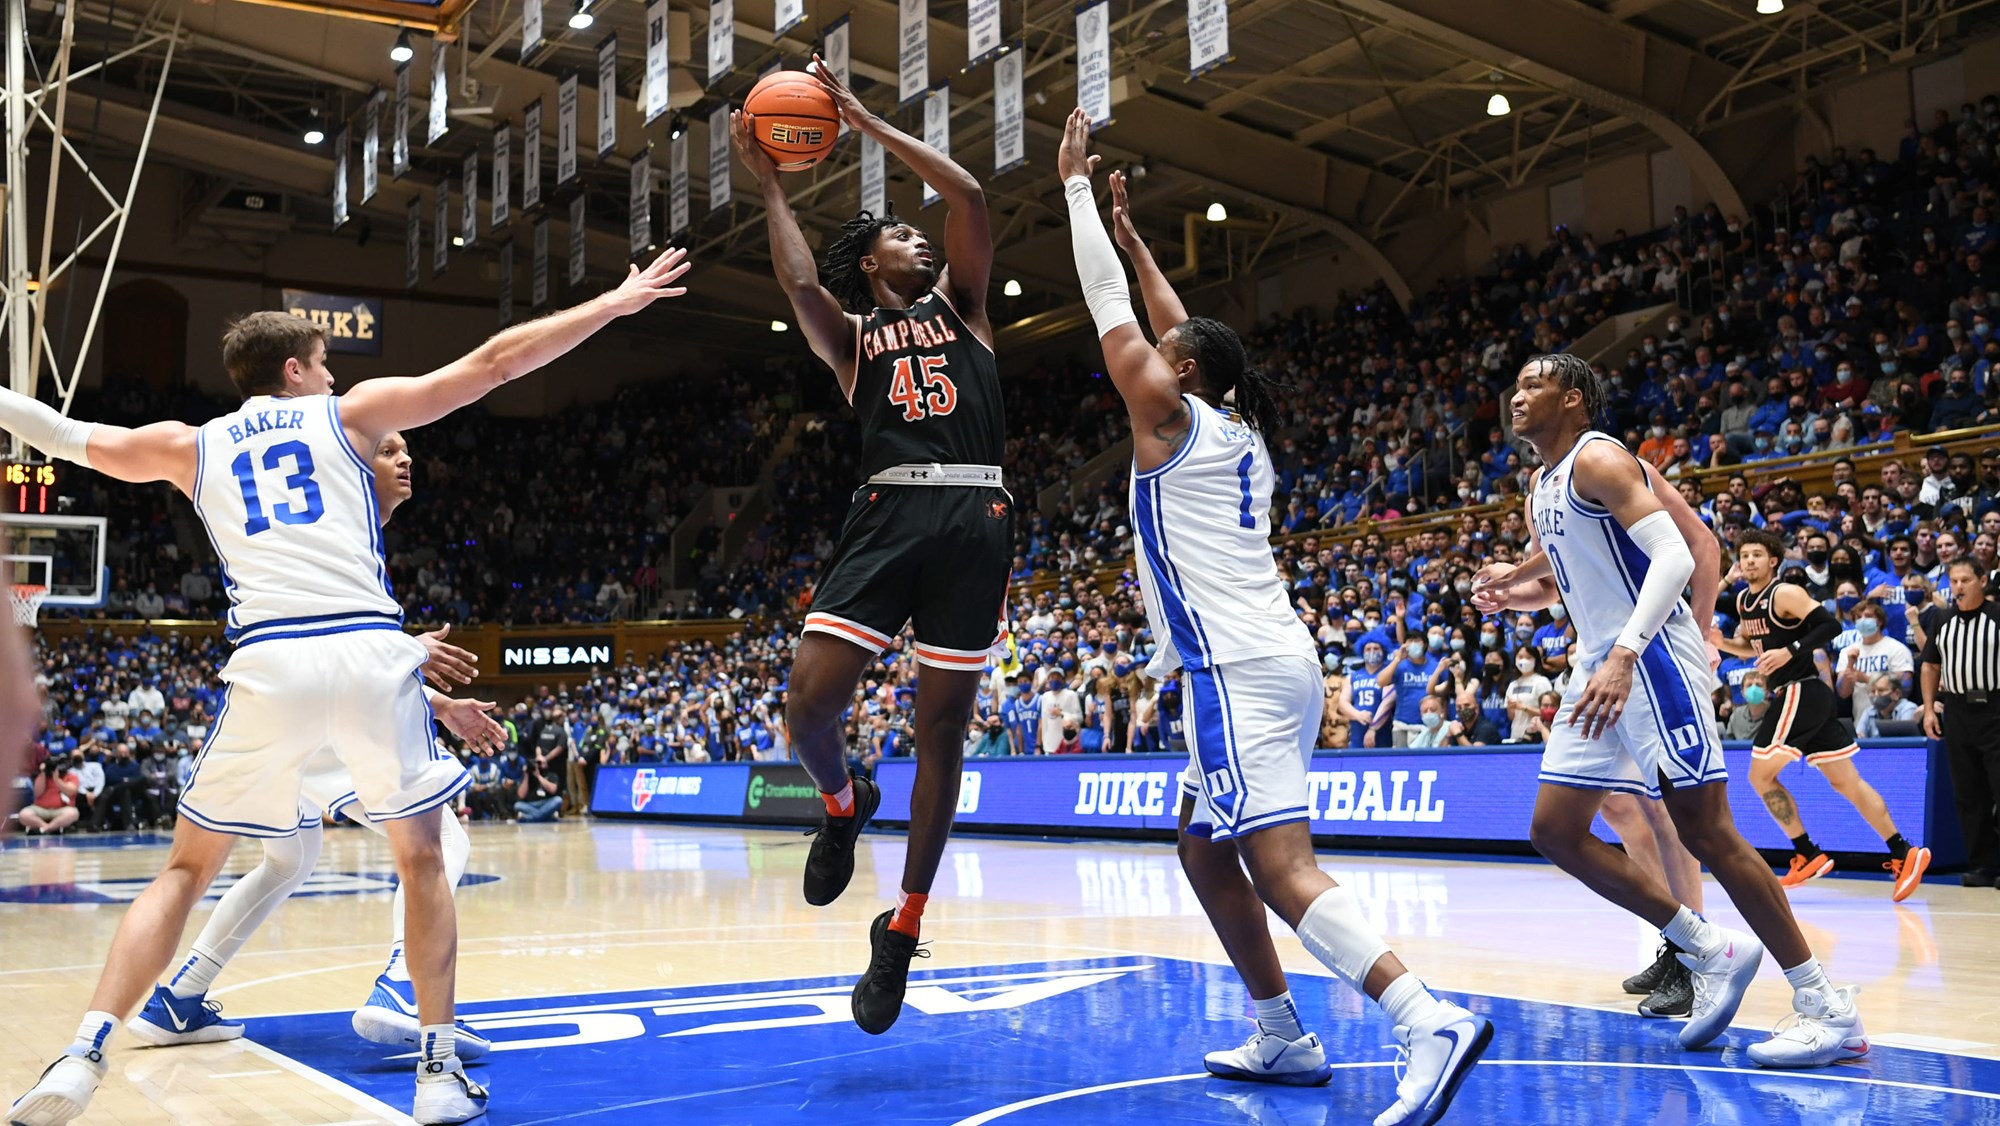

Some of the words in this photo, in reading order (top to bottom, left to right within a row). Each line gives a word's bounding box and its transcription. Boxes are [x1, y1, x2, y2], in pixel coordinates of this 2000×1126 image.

[771, 127, 823, 144] ELITE
[863, 314, 957, 361] CAMPBELL
[888, 353, 957, 421] 45
[227, 409, 304, 444] BAKER
[6, 464, 55, 485] 16:15
[231, 440, 325, 536] 13
[1237, 451, 1255, 529] 1
[1548, 544, 1571, 593] 0
[505, 646, 609, 666] NISSAN
[1358, 690, 1374, 706] 15
[1671, 725, 1699, 750] D
[656, 776, 678, 795] AUTO
[676, 776, 702, 795] PARTS
[1074, 771, 1167, 816] DUKE
[1206, 768, 1233, 798] D
